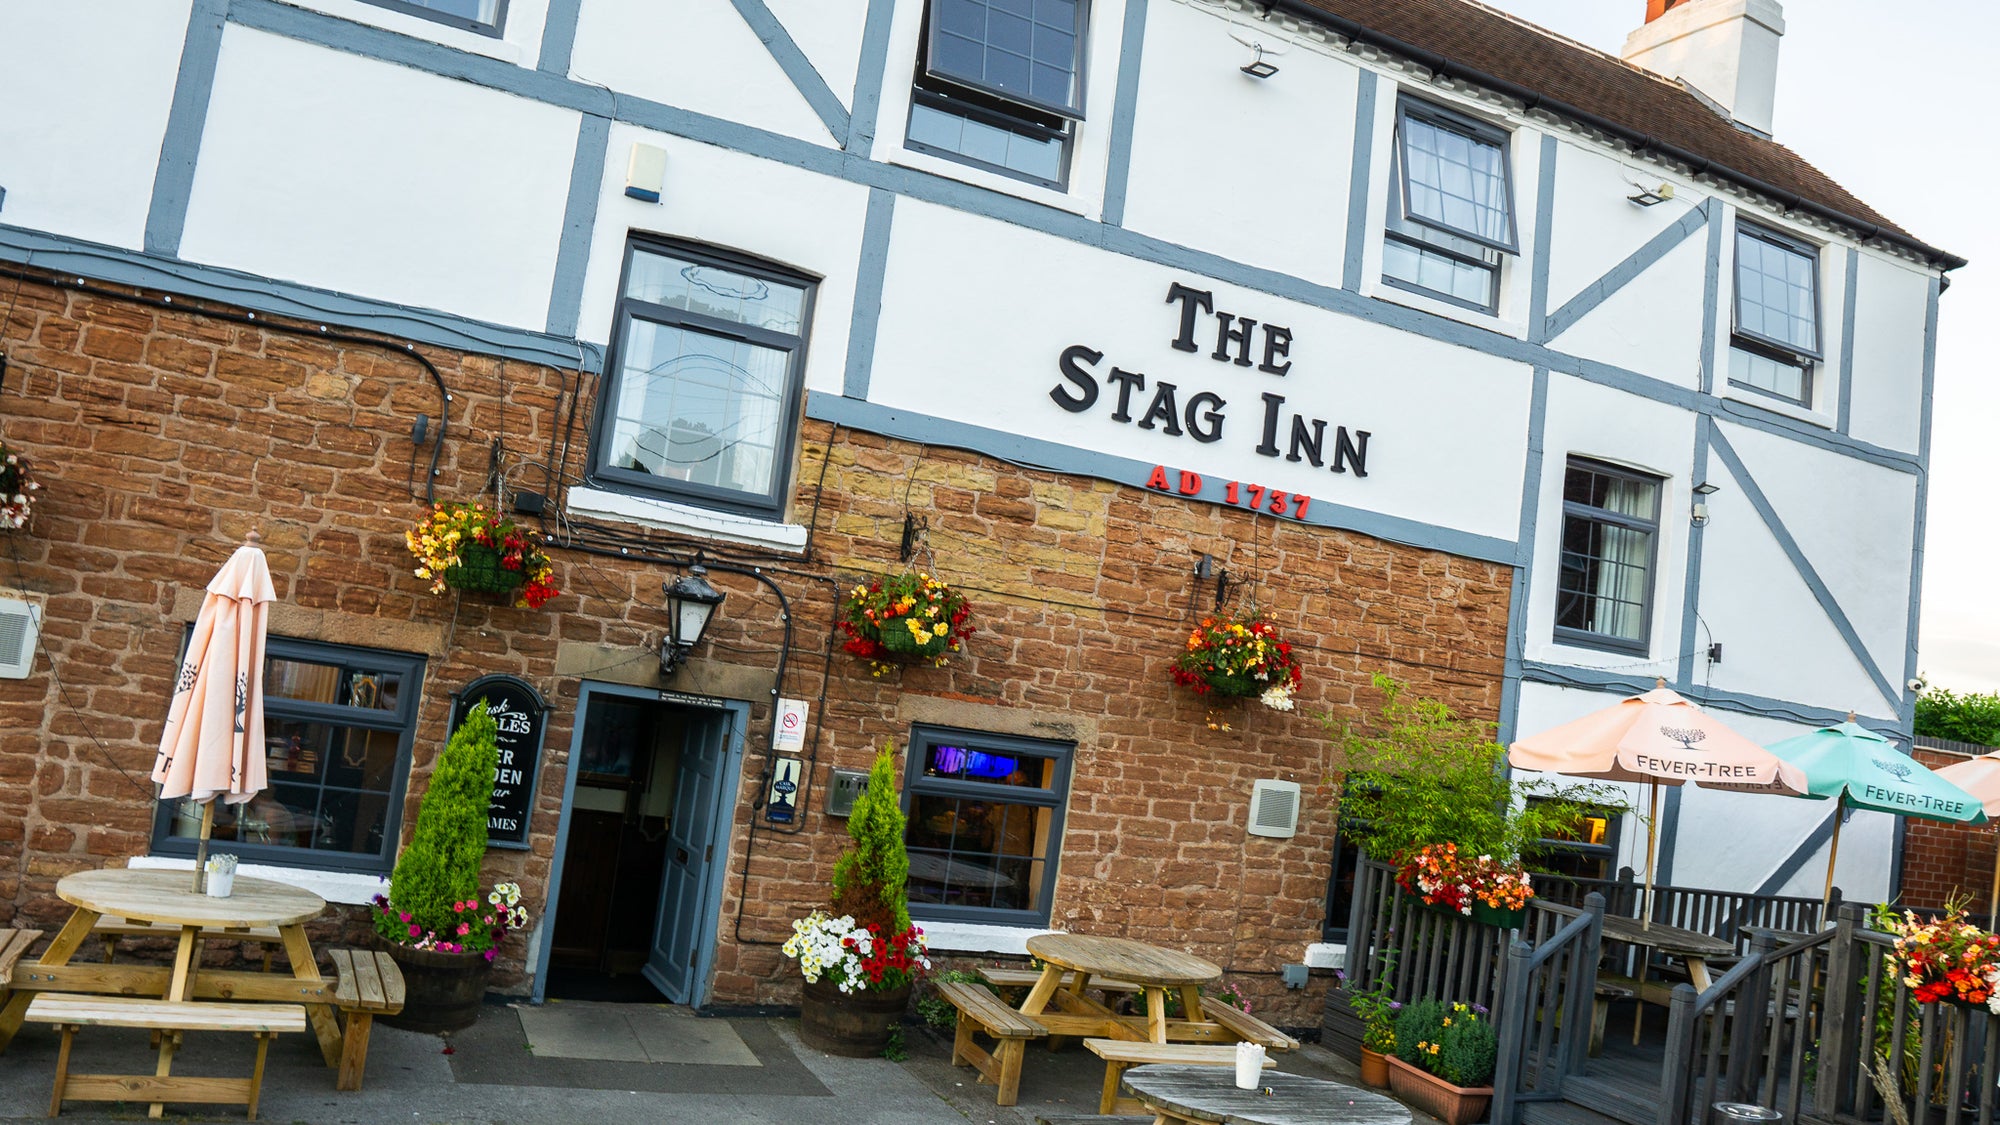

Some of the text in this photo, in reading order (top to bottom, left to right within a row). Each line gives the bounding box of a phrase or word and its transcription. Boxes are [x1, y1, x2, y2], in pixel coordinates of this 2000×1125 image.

[1166, 281, 1293, 377] THE
[1049, 344, 1372, 478] STAG INN
[1146, 465, 1311, 519] AD 1737
[1637, 755, 1757, 777] FEVER-TREE
[1865, 785, 1964, 814] FEVER-TREE
